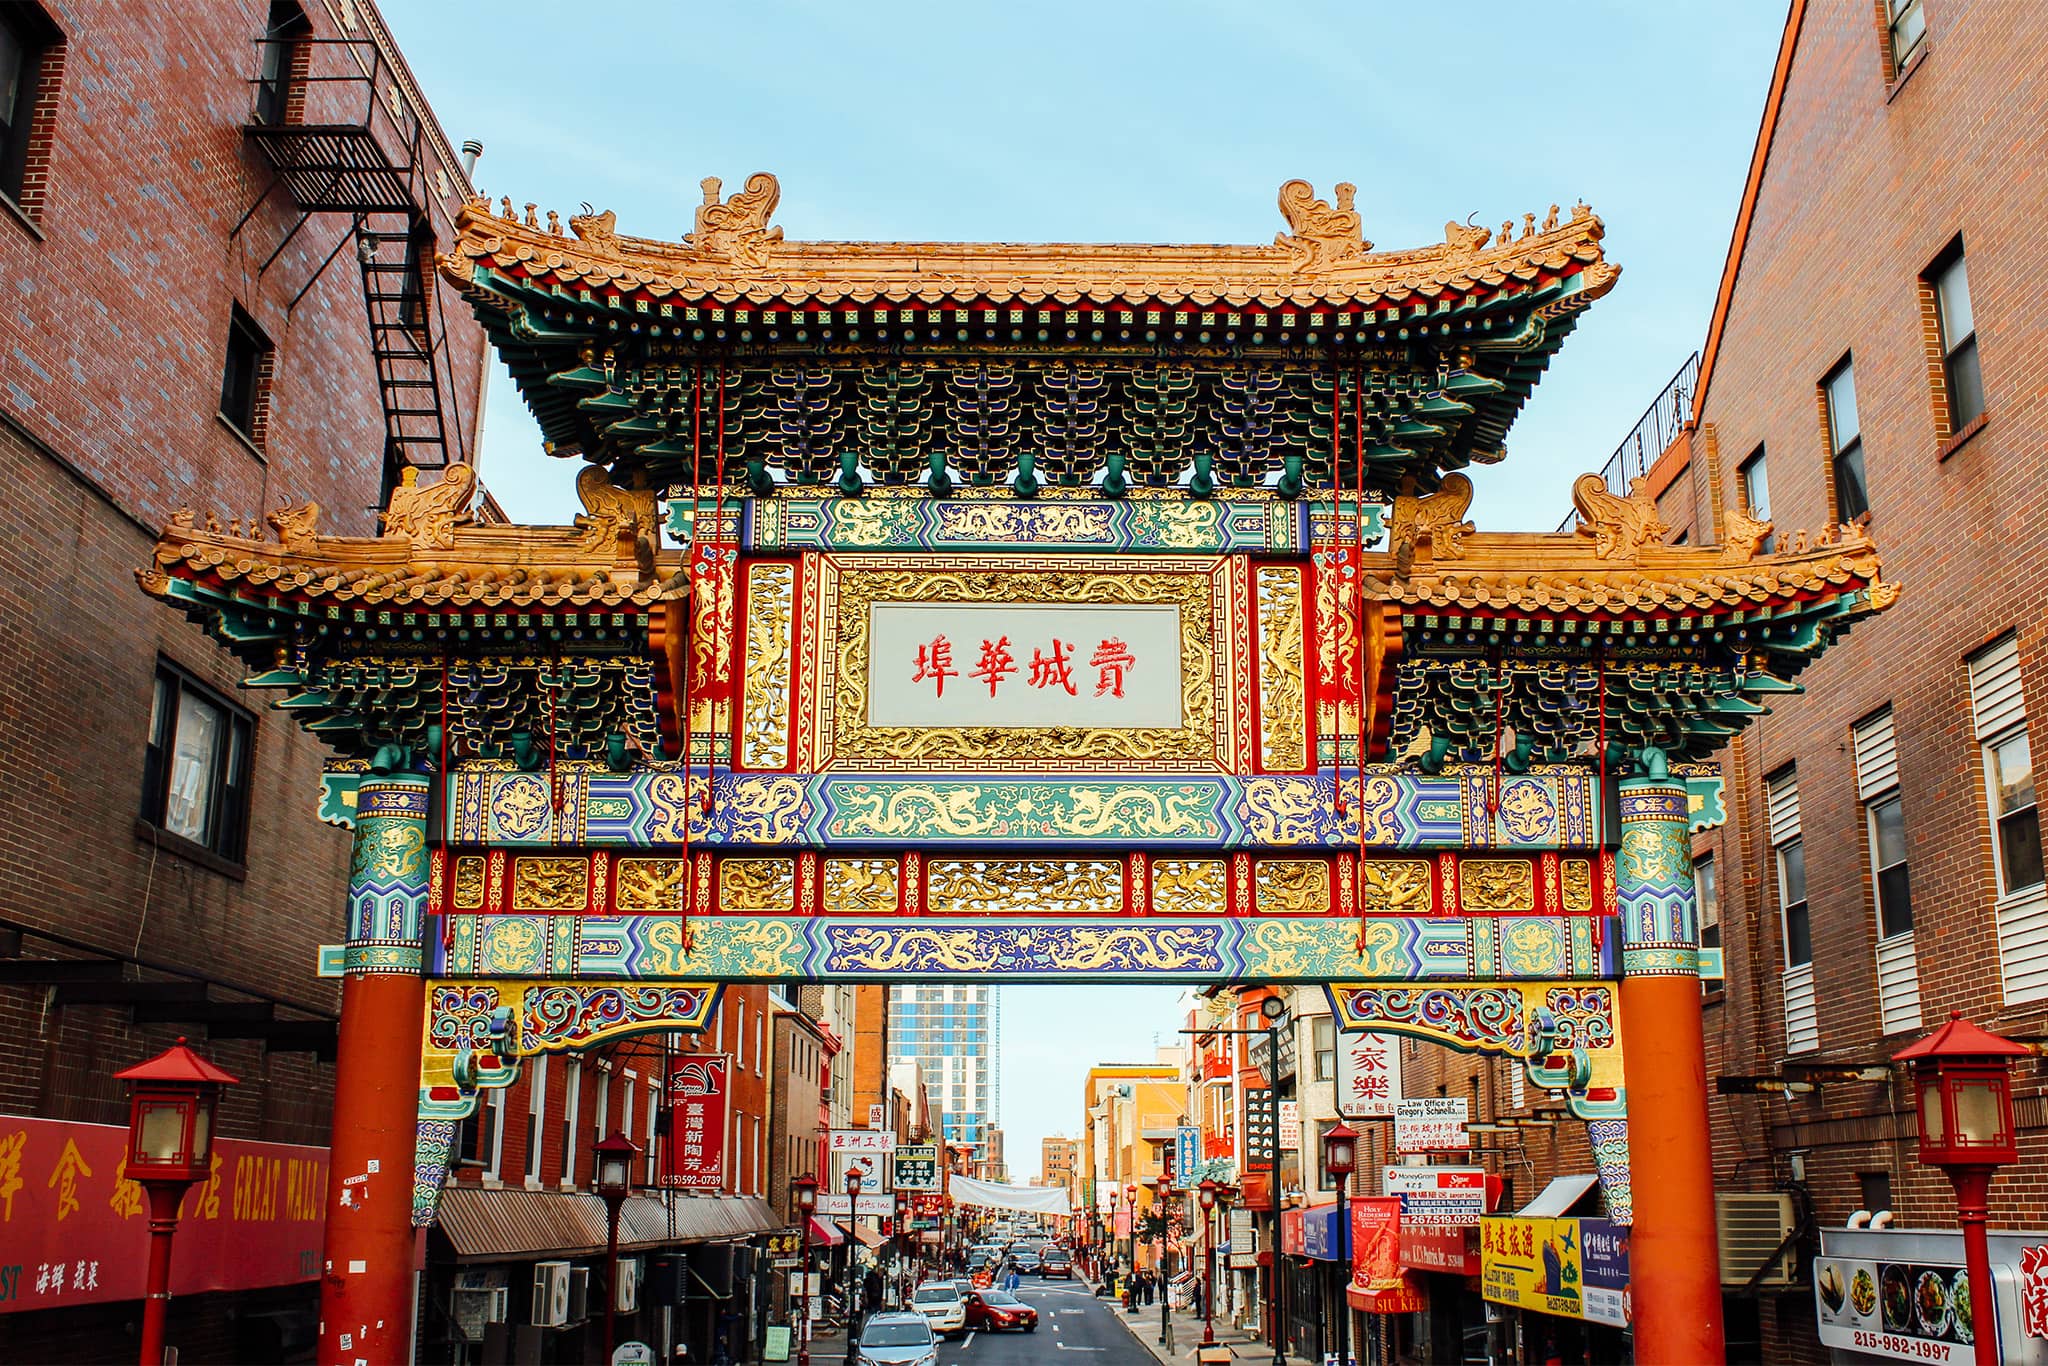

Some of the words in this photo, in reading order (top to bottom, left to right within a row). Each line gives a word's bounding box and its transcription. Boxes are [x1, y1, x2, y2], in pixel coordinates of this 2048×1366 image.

[1424, 1099, 1446, 1107] Office
[1446, 1099, 1455, 1107] of
[1397, 1107, 1424, 1118] Gregory
[233, 1155, 281, 1221] GREAT
[286, 1158, 319, 1221] WALL
[830, 1201, 848, 1209] Asia
[857, 1200, 875, 1209] rafts
[1411, 1215, 1481, 1224] 267.519.0204
[1377, 1298, 1395, 1312] SIU
[1401, 1297, 1425, 1312] KEE
[1854, 1331, 1951, 1361] 215-982-1997
